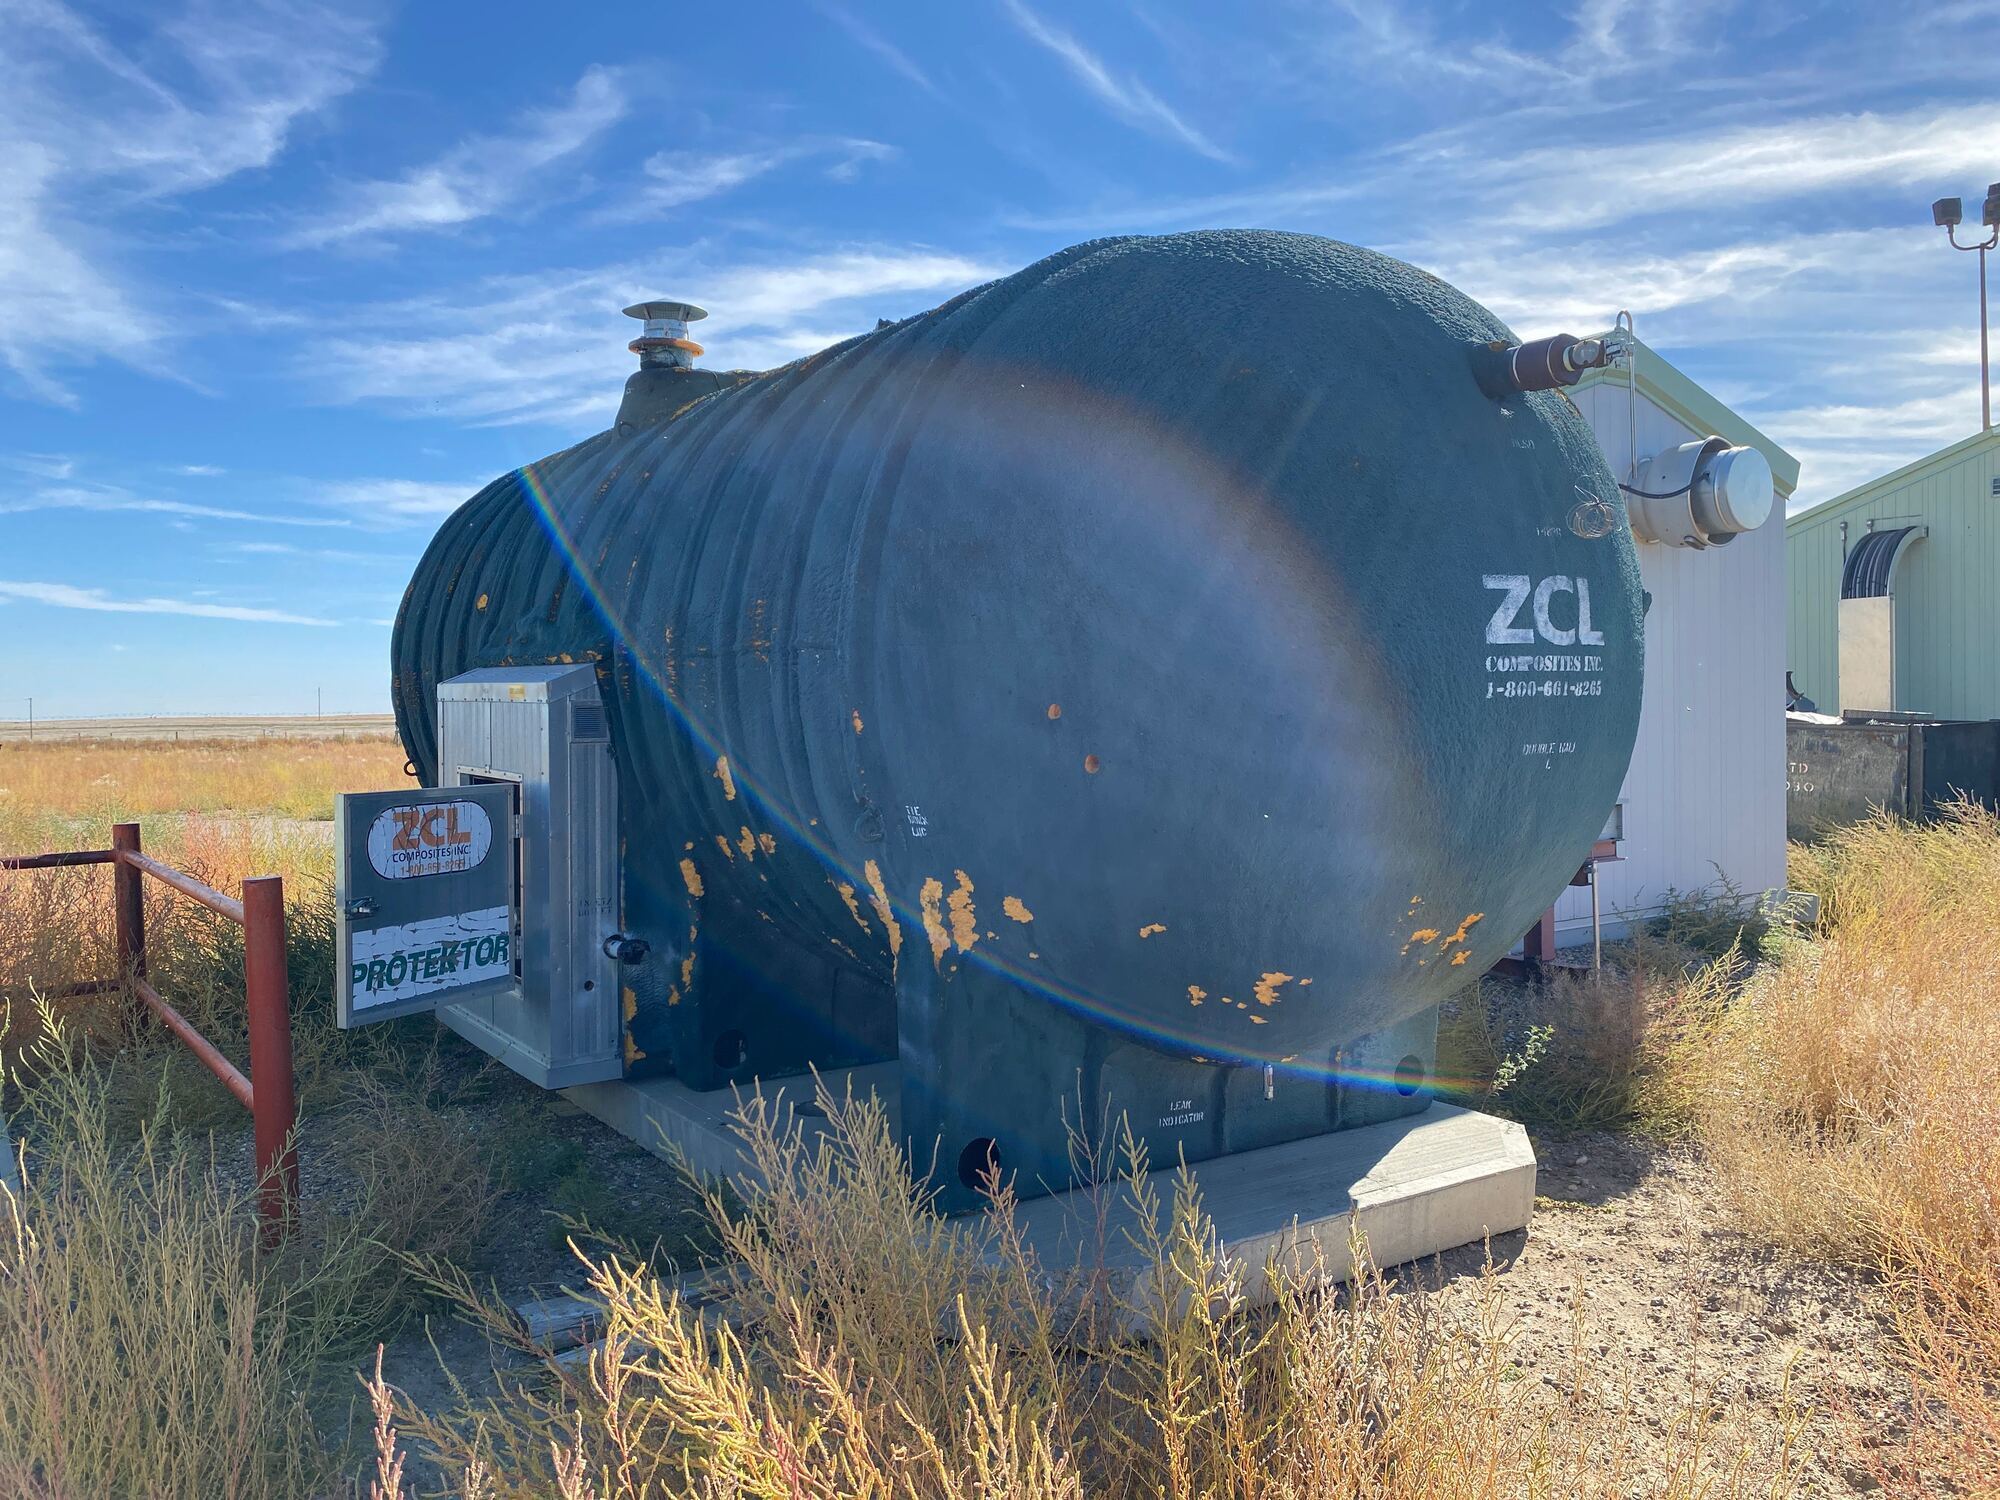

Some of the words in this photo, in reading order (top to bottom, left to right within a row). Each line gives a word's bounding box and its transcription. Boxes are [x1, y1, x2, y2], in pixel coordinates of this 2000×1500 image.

[1482, 574, 1605, 646] ZCL
[1485, 655, 1581, 672] COMPOSITES
[1584, 655, 1604, 672] INC.
[1486, 680, 1602, 699] 1-800-661-8265
[392, 807, 471, 850] ZCL
[392, 846, 451, 863] COMPOSITES
[352, 934, 510, 992] PROTEKTOR
[1170, 1100, 1192, 1111] LEAK
[1158, 1111, 1204, 1128] INDICATOR
